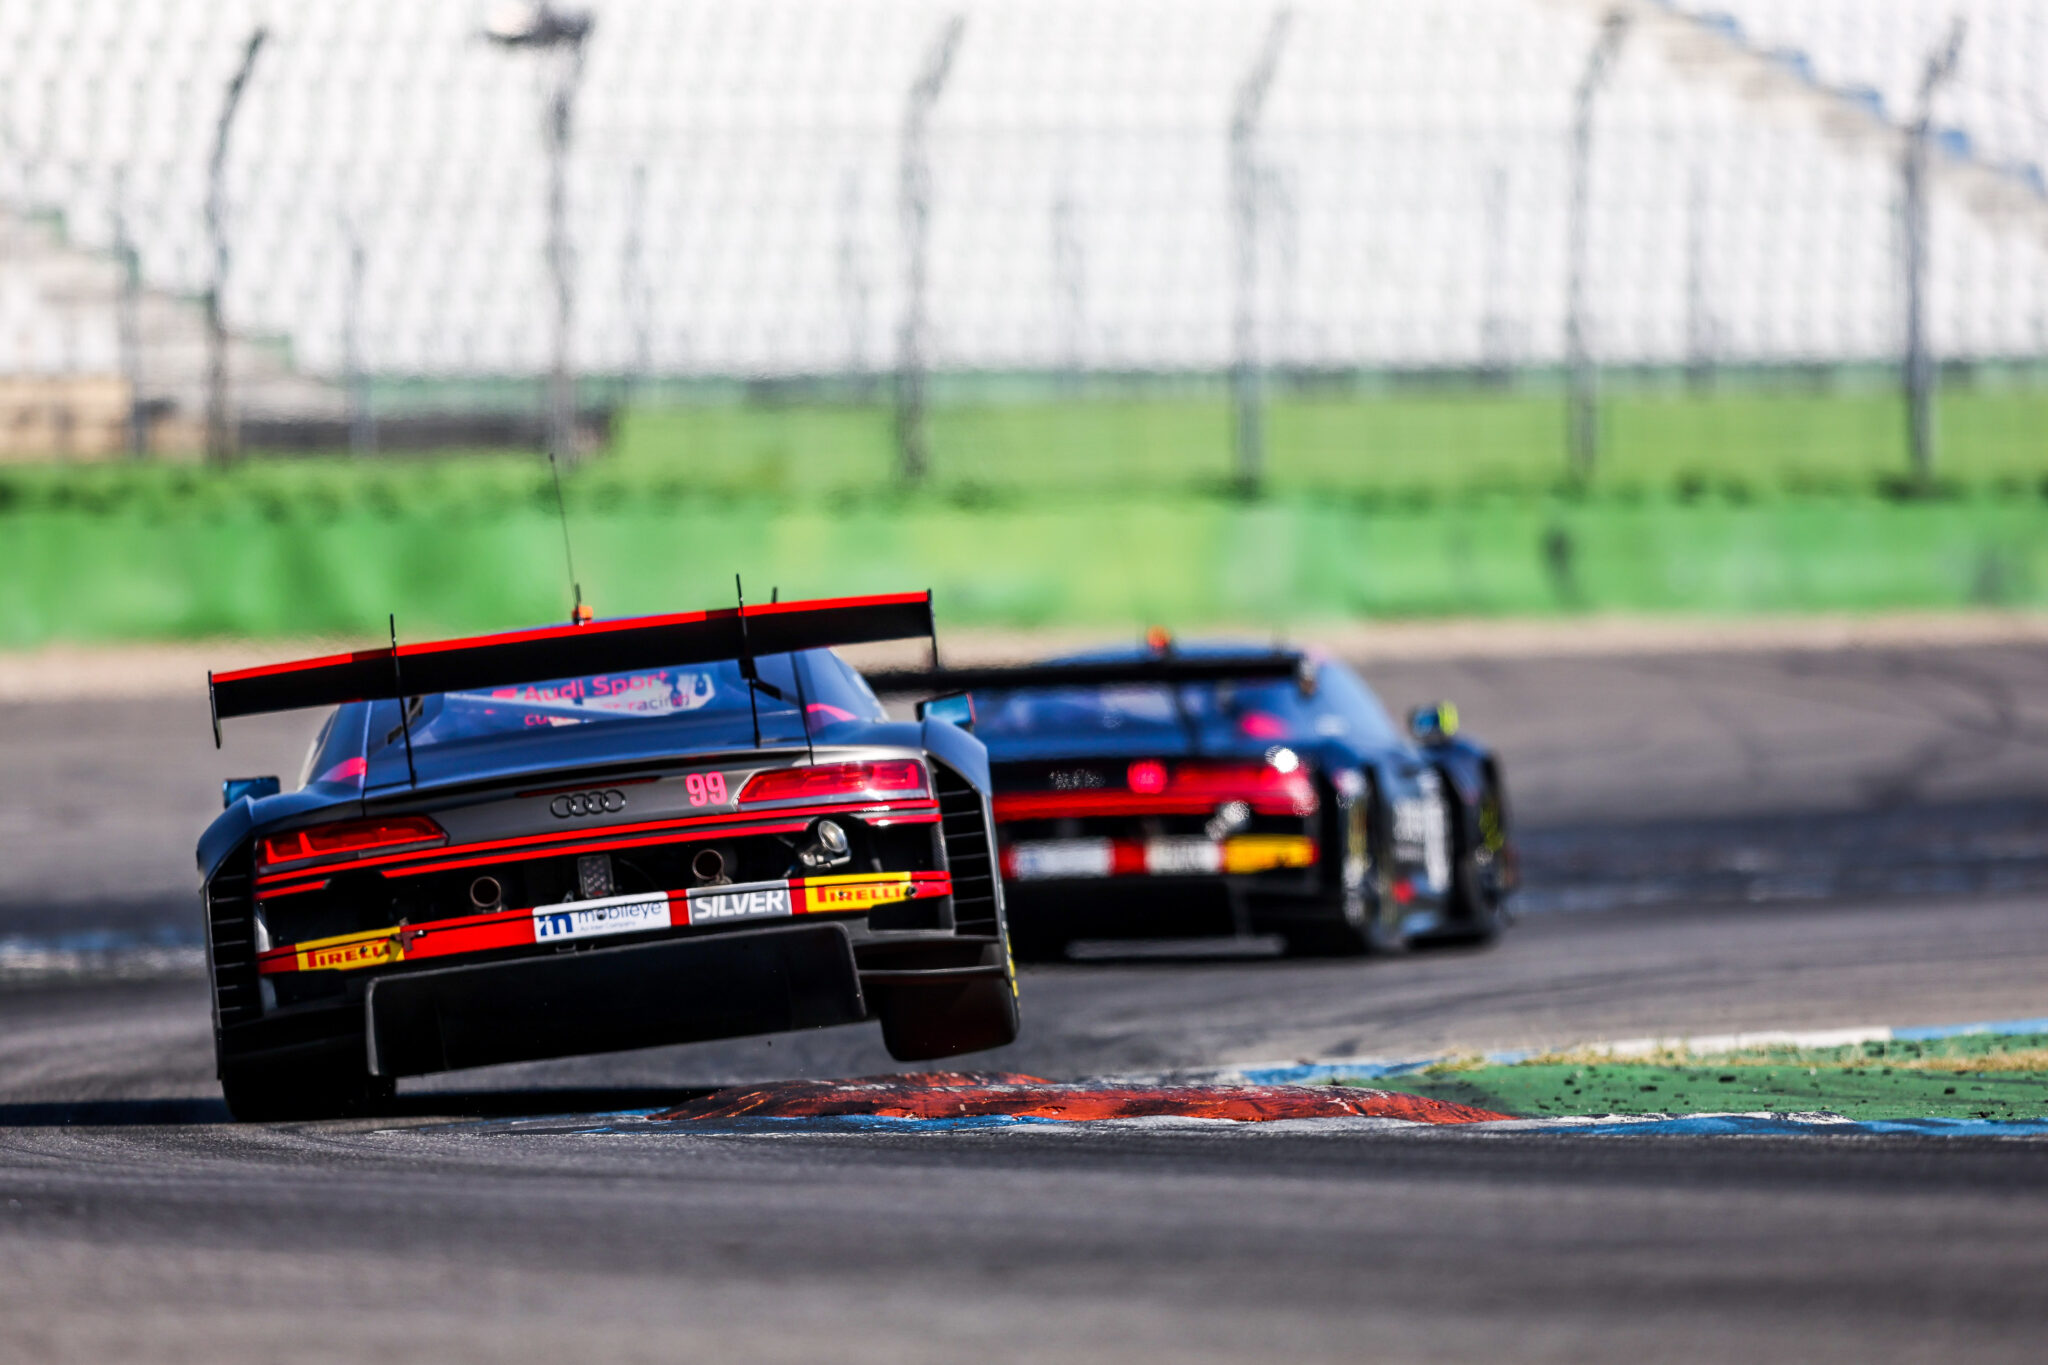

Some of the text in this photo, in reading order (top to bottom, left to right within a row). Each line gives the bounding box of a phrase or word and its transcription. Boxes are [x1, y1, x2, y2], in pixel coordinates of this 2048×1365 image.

[523, 670, 670, 702] Audi Sport
[685, 771, 728, 807] 99
[694, 889, 785, 919] SILVER
[816, 882, 901, 904] PIRELLI
[577, 901, 662, 923] mobileye
[306, 937, 391, 968] PIRELLI
